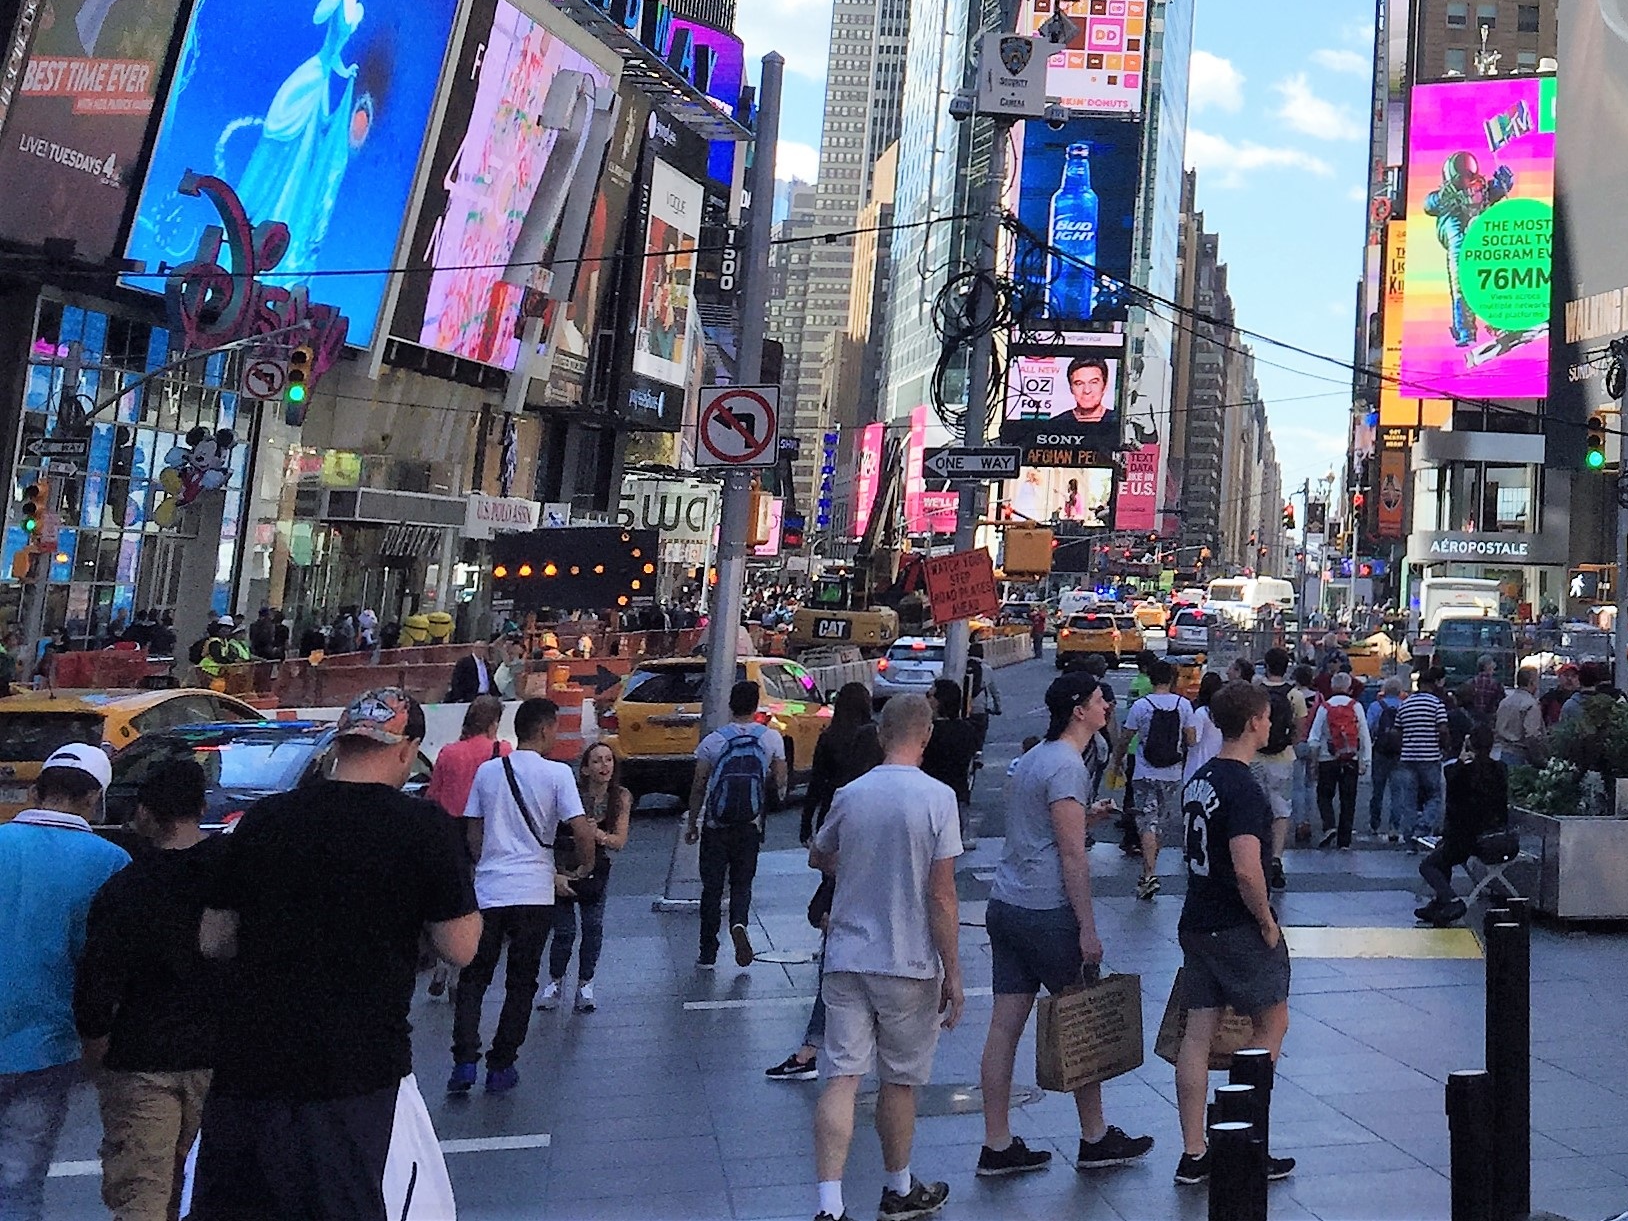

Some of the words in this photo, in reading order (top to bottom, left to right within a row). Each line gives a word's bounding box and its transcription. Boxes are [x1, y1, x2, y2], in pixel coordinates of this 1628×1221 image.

[23, 60, 67, 92] BEST
[66, 61, 104, 93] TIME
[106, 61, 150, 94] EVER
[1087, 98, 1129, 108] DONUTS
[20, 134, 48, 158] LIVE!
[48, 142, 102, 175] TUESDAYS
[1055, 216, 1093, 231] BUD
[1484, 221, 1508, 232] THE
[1513, 219, 1552, 231] MOST
[1054, 230, 1095, 241] IGHT
[1482, 234, 1532, 247] SOCIAL
[1465, 248, 1533, 261] PROGRAM
[1477, 267, 1552, 290] 76MM
[1021, 366, 1039, 374] ALL
[1026, 379, 1051, 393] OZ
[1021, 400, 1042, 409] FOX
[1044, 400, 1052, 409] 5
[1037, 435, 1085, 445] SONY
[936, 457, 964, 469] ONE
[981, 457, 1012, 469] WAY
[1028, 450, 1072, 464] AFGHAN
[1132, 453, 1155, 462] TEXT
[1130, 462, 1154, 472] DATA
[1127, 472, 1144, 481] IKE
[1131, 482, 1155, 495] U.S.
[1430, 537, 1528, 556] AÉROPOSTALE
[818, 619, 846, 638] CAT
